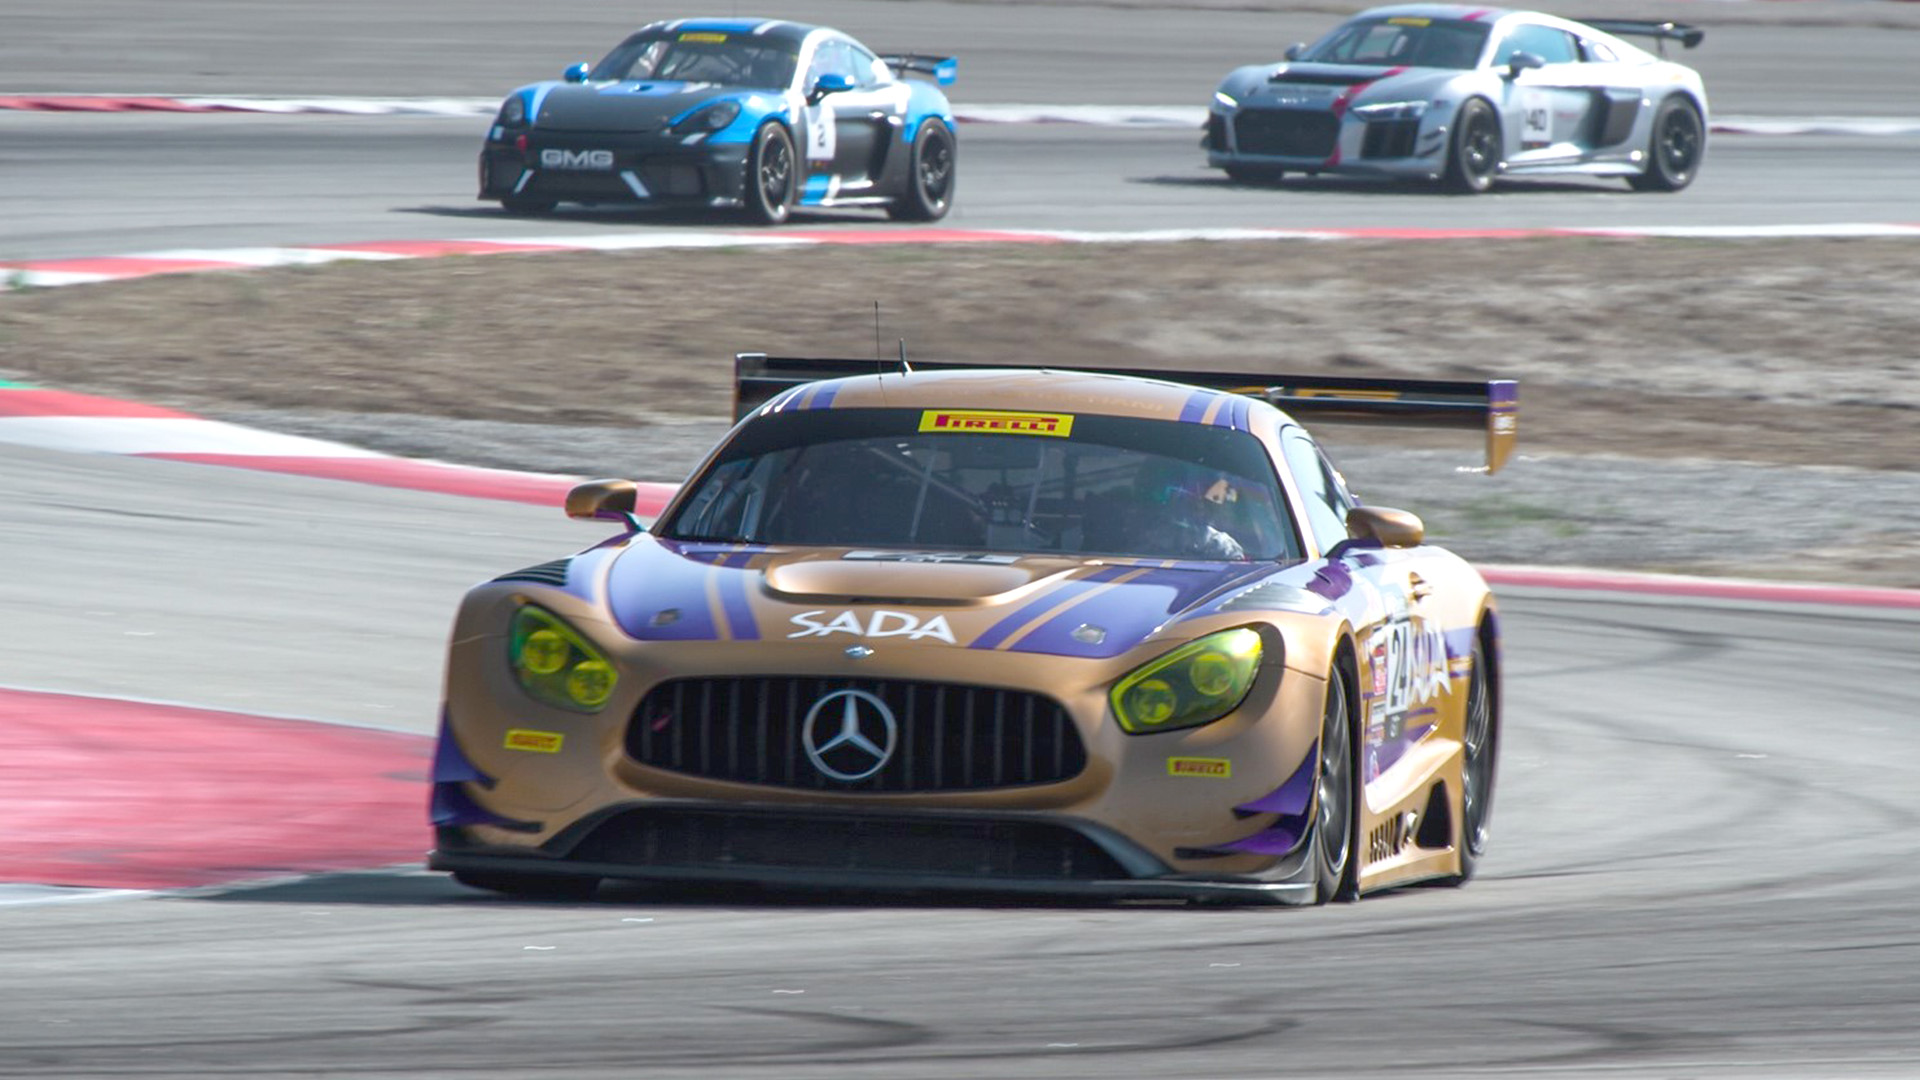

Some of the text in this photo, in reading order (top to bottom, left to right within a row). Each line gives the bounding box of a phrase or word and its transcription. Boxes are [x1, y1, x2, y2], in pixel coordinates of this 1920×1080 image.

[541, 149, 614, 169] GMG
[935, 414, 1059, 431] PIRELLI
[786, 610, 957, 644] SADA
